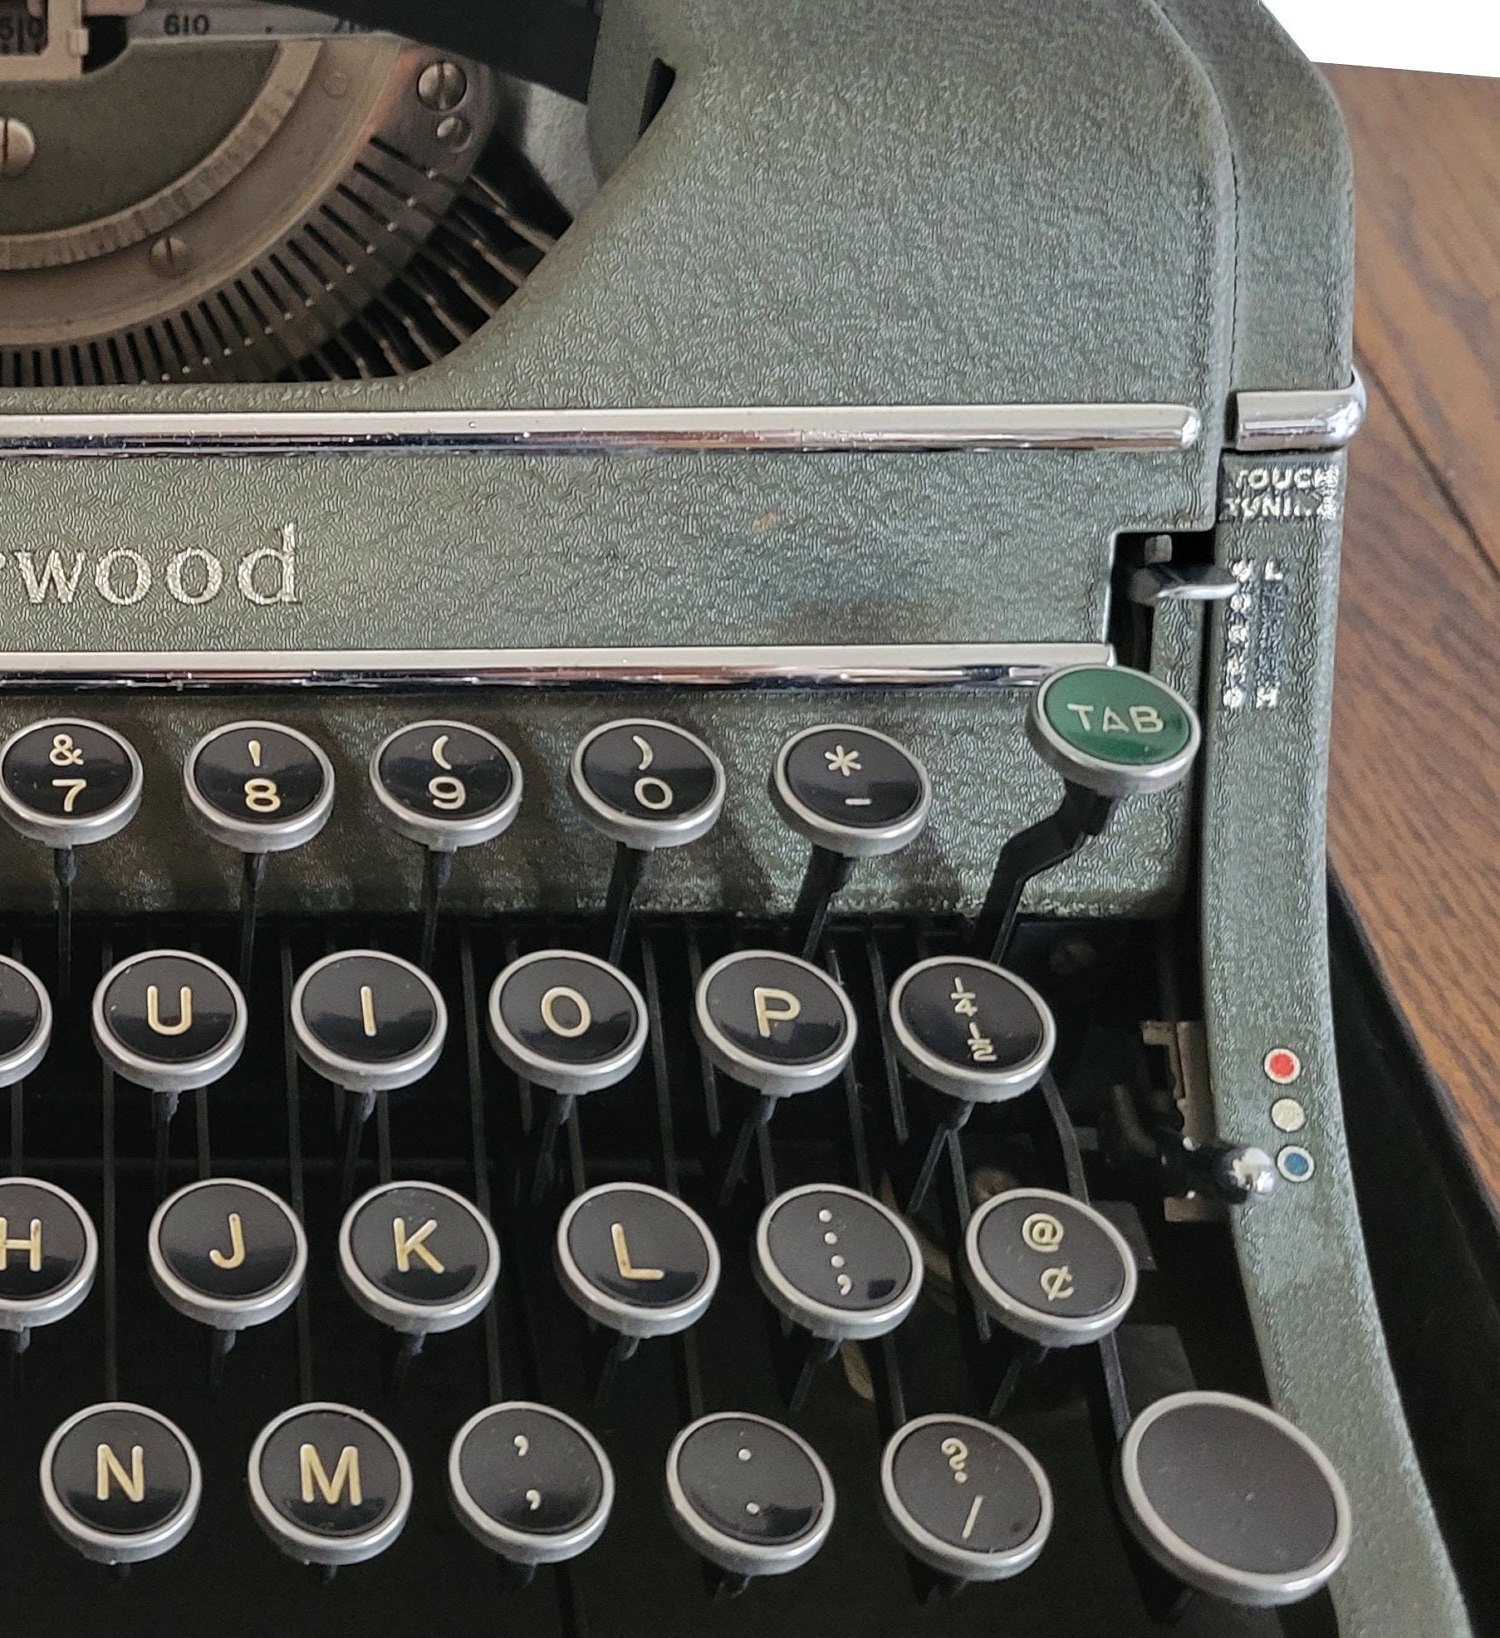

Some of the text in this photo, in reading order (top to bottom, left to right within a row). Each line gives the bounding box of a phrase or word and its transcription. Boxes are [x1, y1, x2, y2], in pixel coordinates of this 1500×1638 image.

[163, 13, 210, 36] 610
[1236, 467, 1339, 490] TOUCH
[1066, 703, 1164, 733] TAB
[49, 733, 84, 766] &
[248, 740, 261, 767] !
[431, 735, 452, 770] (
[632, 735, 653, 770] )
[51, 778, 87, 812] 7
[244, 777, 281, 813] 8
[428, 776, 466, 810] 9
[146, 985, 192, 1035] U
[360, 985, 377, 1037] I
[540, 986, 591, 1038] O
[753, 986, 801, 1038] P
[209, 1213, 245, 1269] J
[393, 1217, 445, 1274] K
[611, 1223, 664, 1279] L
[1022, 1213, 1064, 1253] @
[1040, 1265, 1075, 1302] ¢
[96, 1443, 144, 1502] N
[299, 1443, 362, 1506] M
[941, 1437, 968, 1483] ?
